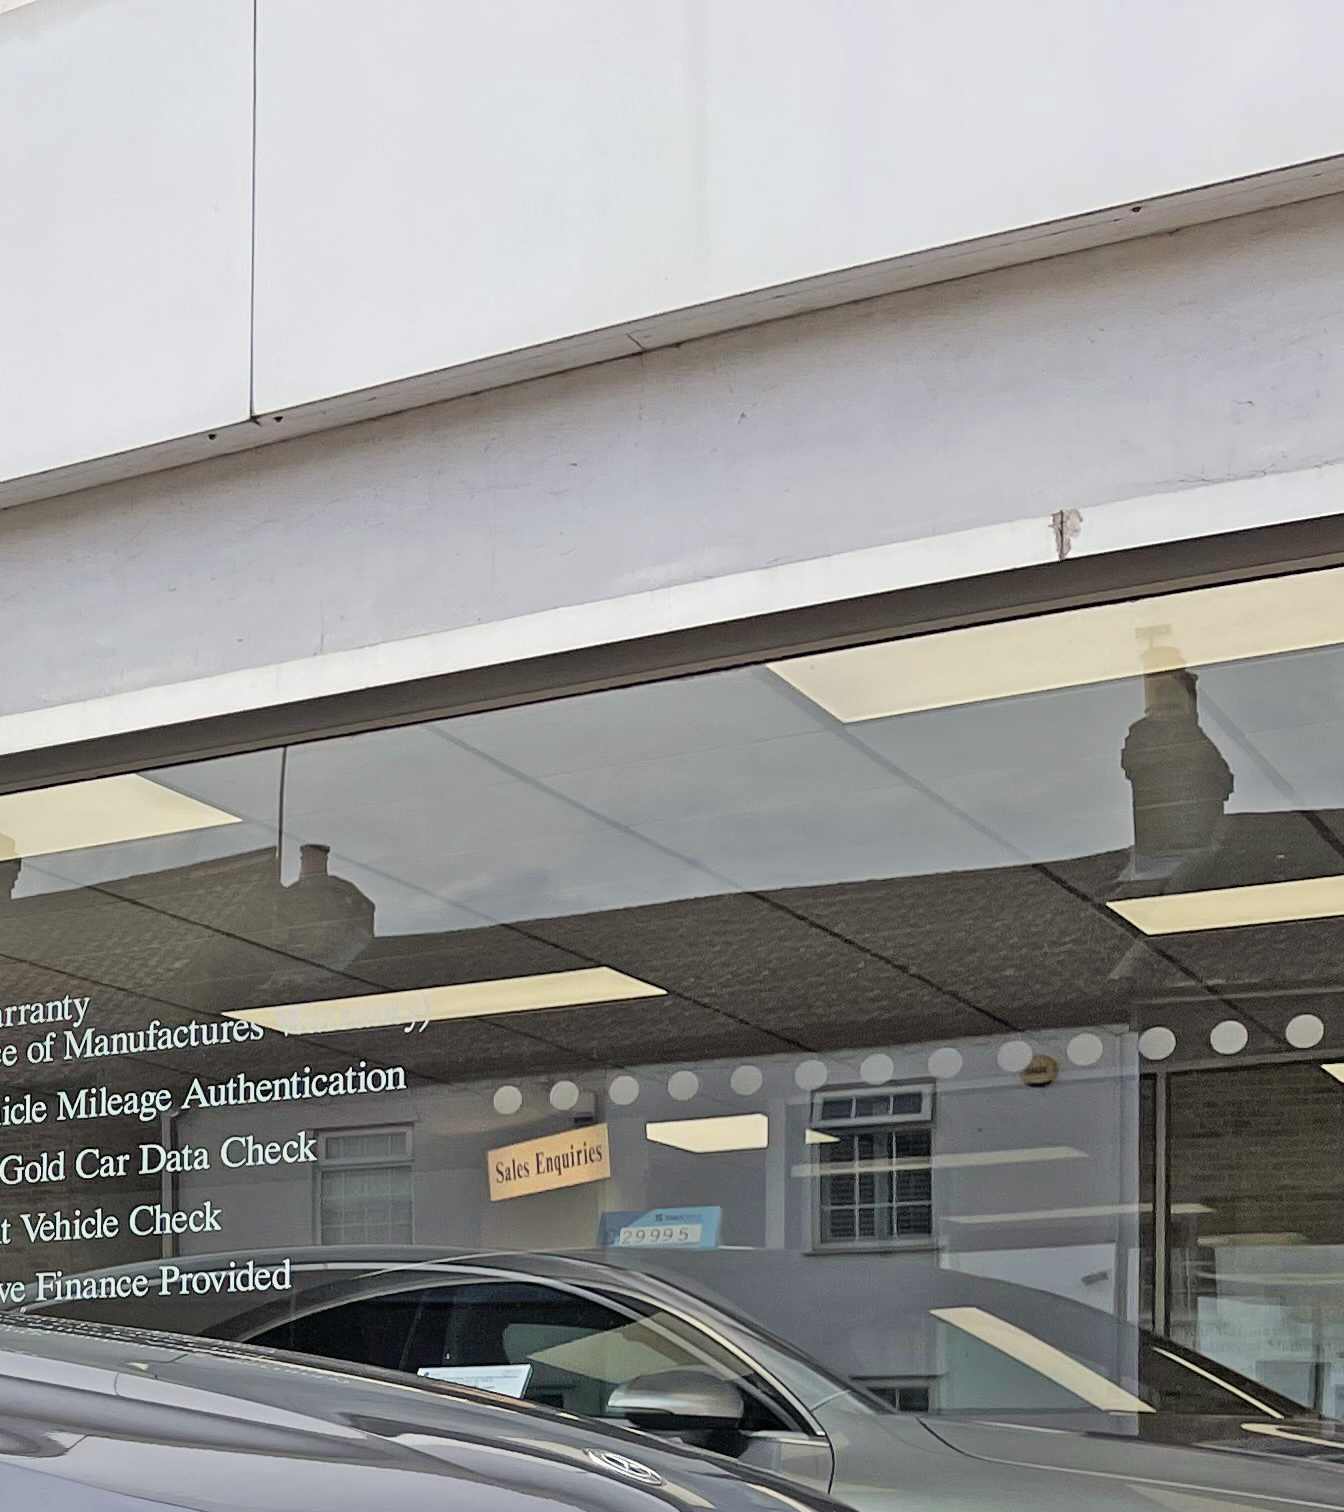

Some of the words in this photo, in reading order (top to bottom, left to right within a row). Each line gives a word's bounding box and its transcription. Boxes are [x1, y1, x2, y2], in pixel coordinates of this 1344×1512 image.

[27, 1032, 58, 1063] of
[63, 1019, 265, 1061] Manufactures
[57, 1086, 173, 1122] Mileage
[180, 1060, 408, 1110] Authentication
[0, 1151, 66, 1186] Gold
[75, 1148, 130, 1179] Car
[138, 1143, 211, 1175] Data
[220, 1130, 318, 1168] Check
[495, 1157, 530, 1184] Sales
[535, 1141, 603, 1177] Enquiries
[20, 1208, 120, 1242] Vehicle
[129, 1200, 223, 1237] Check
[35, 1271, 150, 1301] Finance
[158, 1258, 293, 1296] Provided
